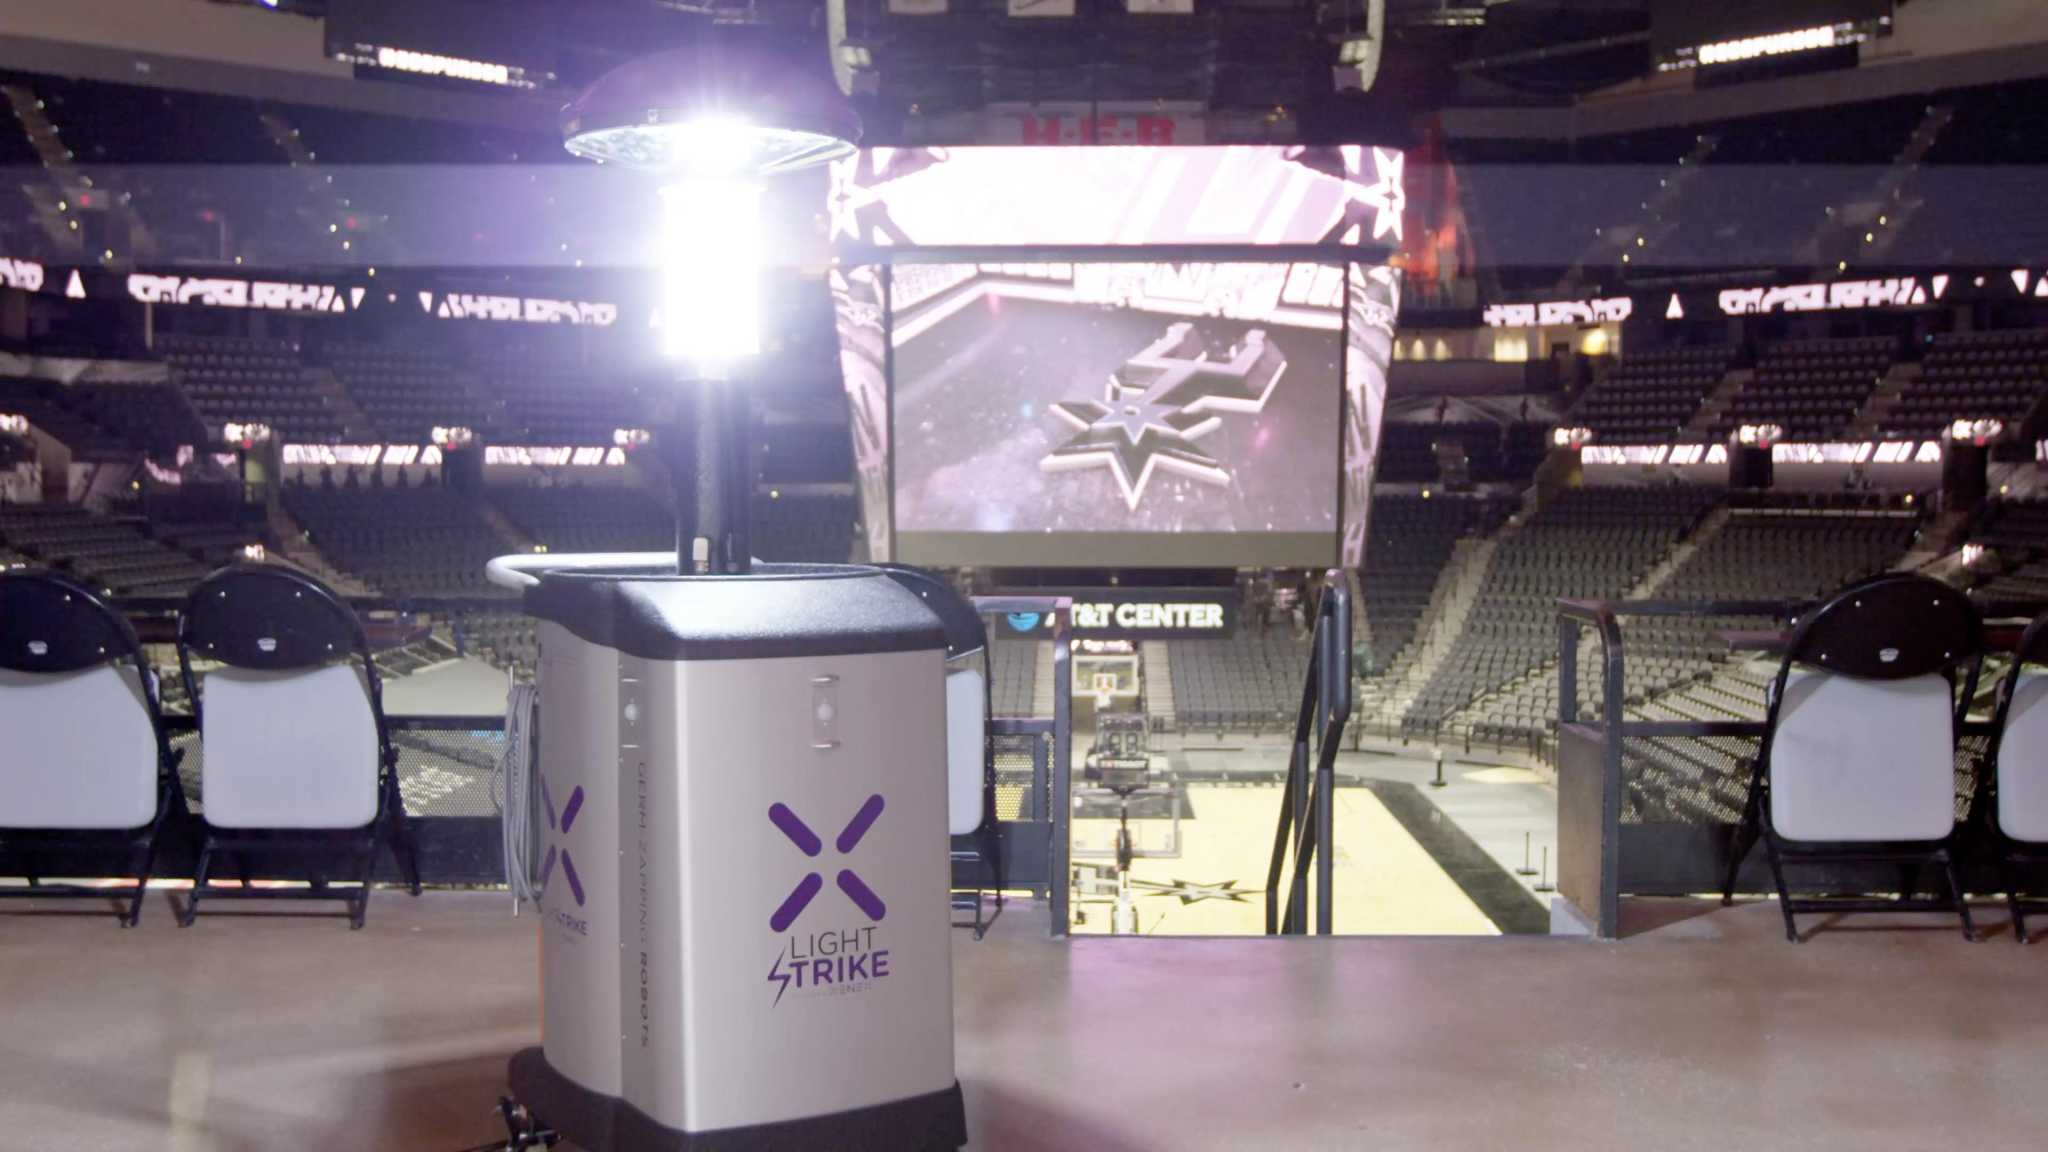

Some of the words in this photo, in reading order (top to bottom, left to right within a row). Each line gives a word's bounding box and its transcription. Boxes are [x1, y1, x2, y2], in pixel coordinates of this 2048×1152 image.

[1115, 603, 1224, 627] CENTER
[790, 926, 877, 959] LIGHT
[640, 951, 650, 1047] ROBOTS
